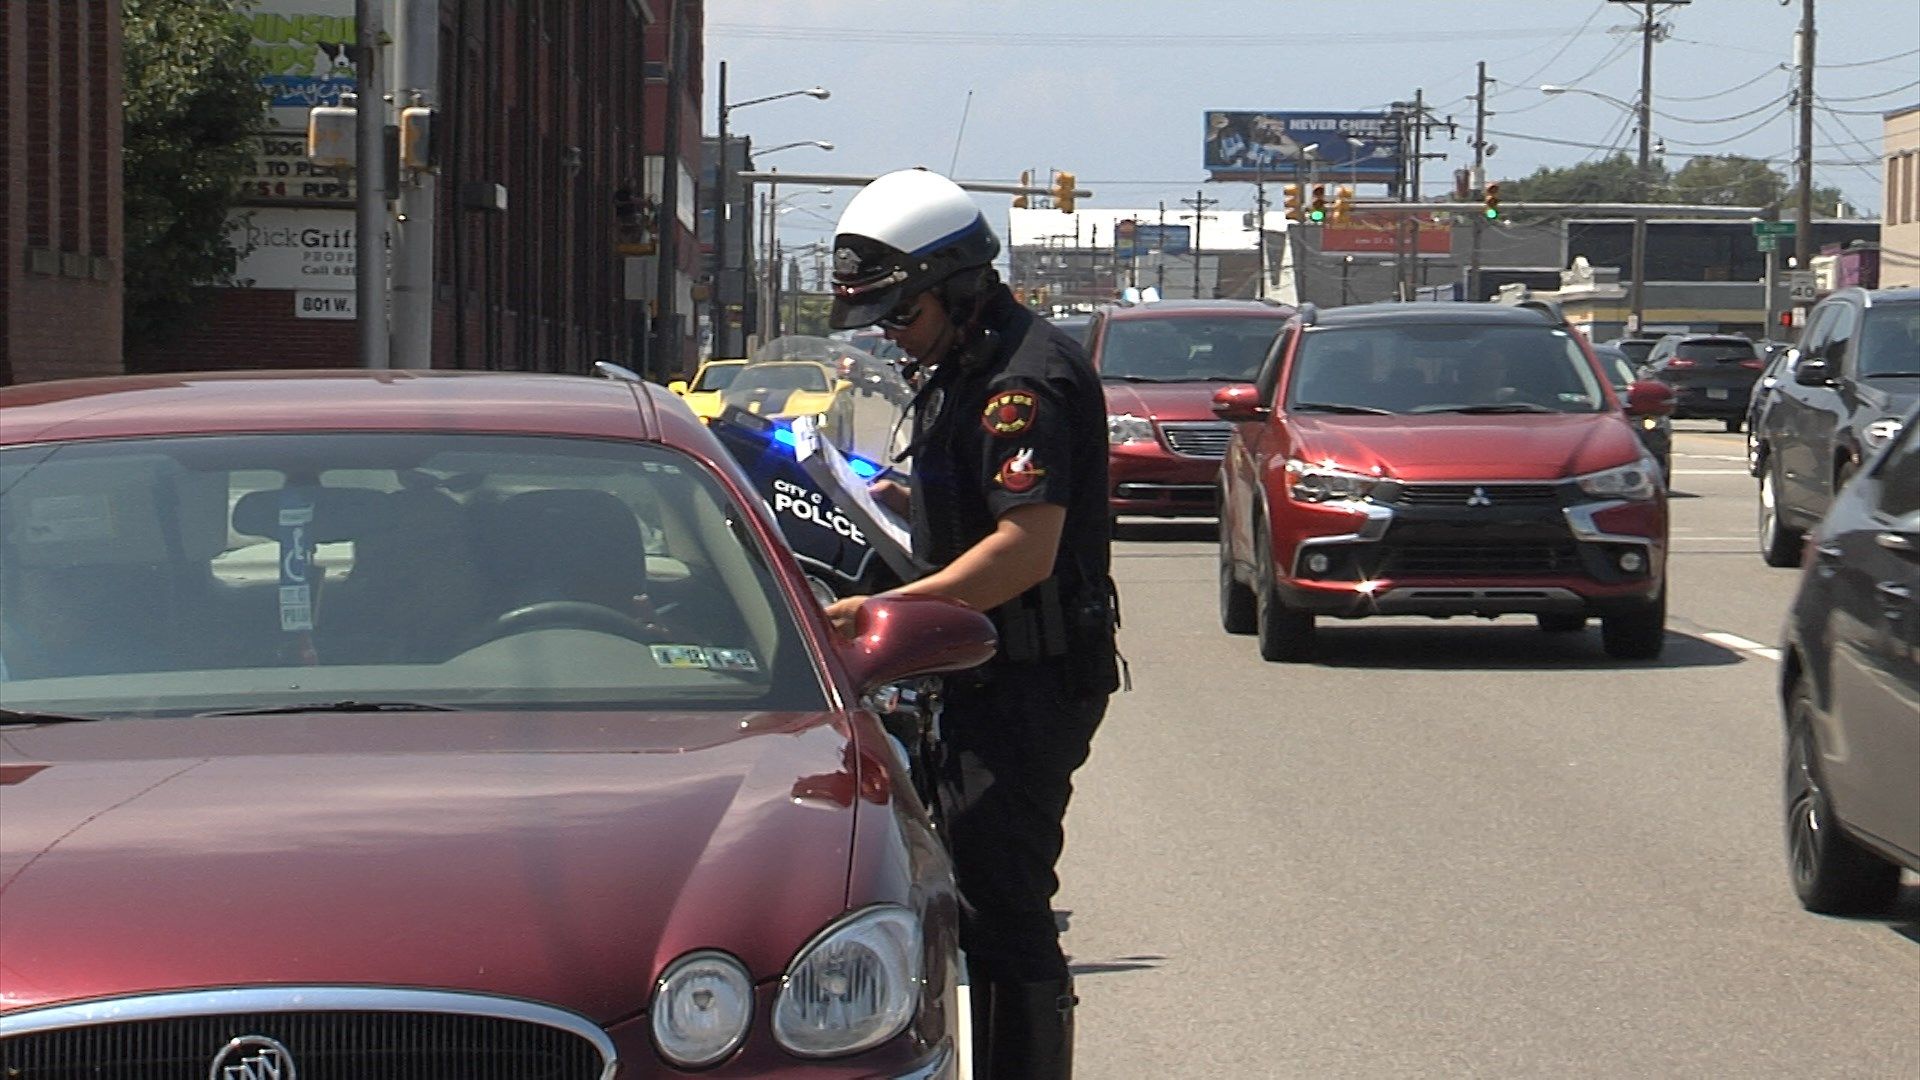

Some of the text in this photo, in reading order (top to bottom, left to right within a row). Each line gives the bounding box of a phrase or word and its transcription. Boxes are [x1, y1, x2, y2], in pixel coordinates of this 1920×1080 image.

[1289, 119, 1336, 130] NEVER
[302, 297, 330, 312] 801
[774, 480, 808, 498] CITY
[775, 493, 867, 546] POLICE
